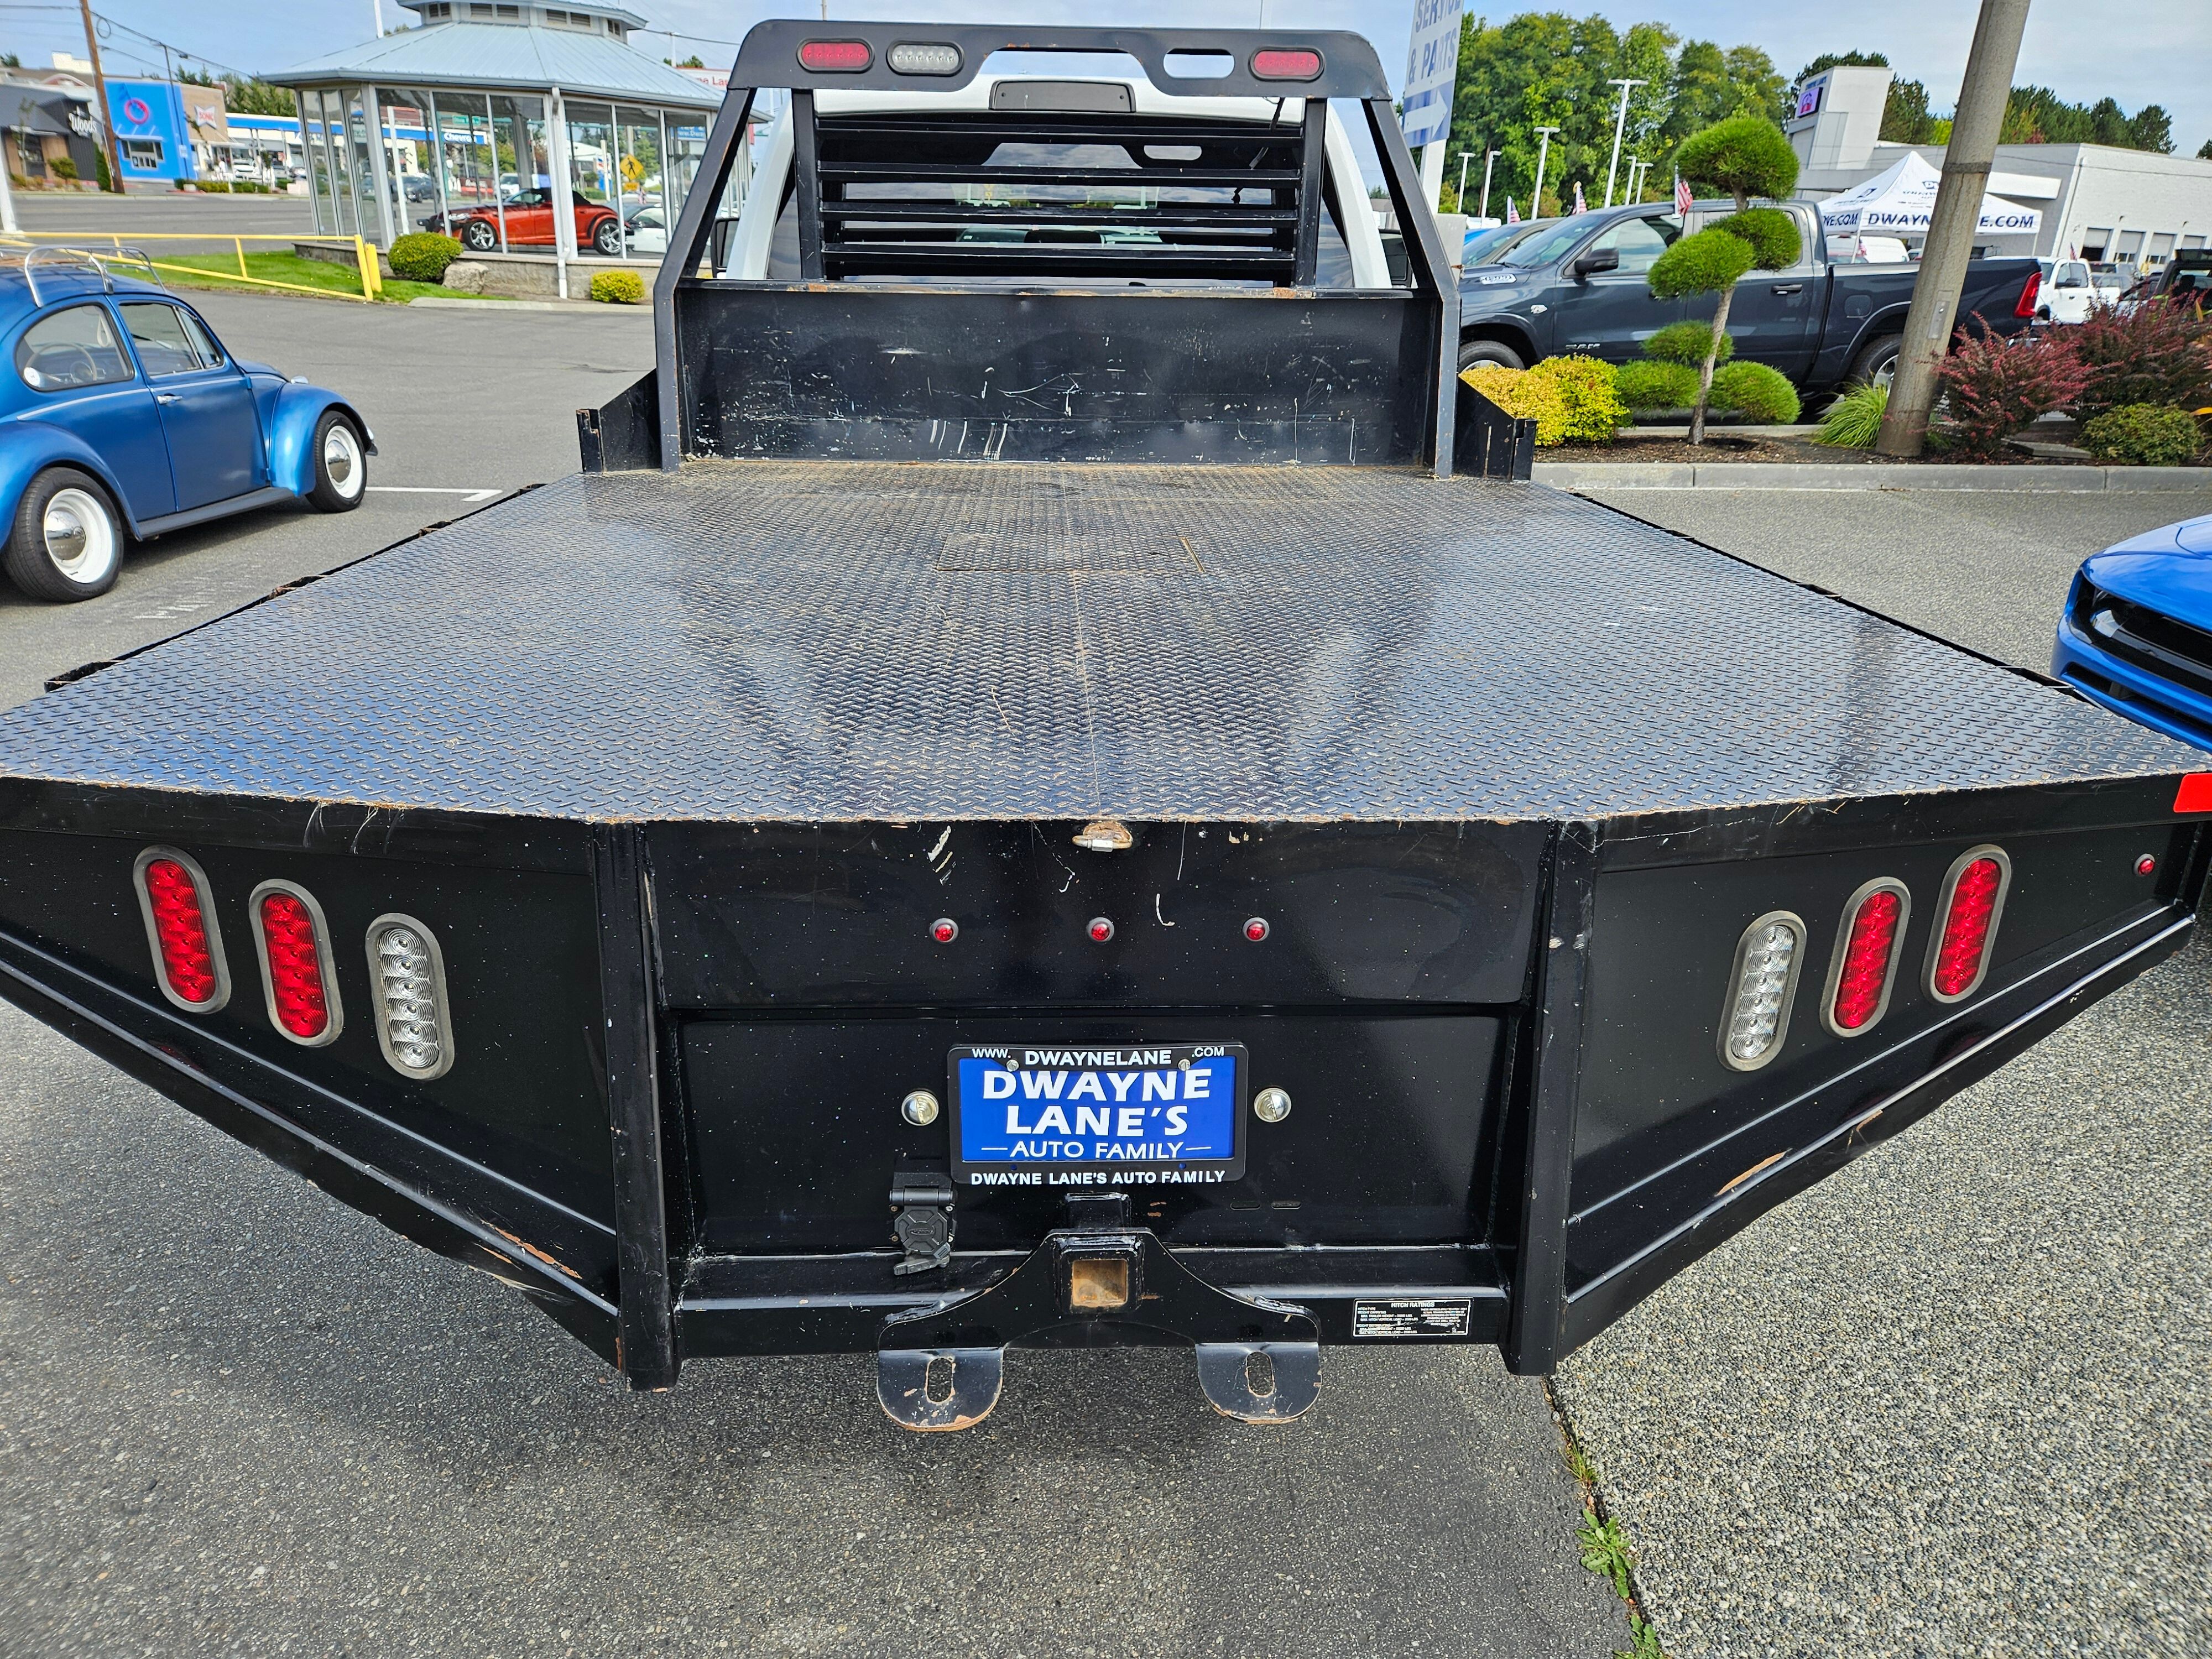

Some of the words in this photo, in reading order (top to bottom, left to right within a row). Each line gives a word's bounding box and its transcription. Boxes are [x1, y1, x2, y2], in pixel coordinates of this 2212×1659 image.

[1416, 0, 1460, 33] SERV
[1408, 48, 1416, 85] &
[1421, 27, 1457, 80] PARTS
[69, 112, 97, 133] Woods
[1025, 1050, 1172, 1066] DWAYNELANE
[1191, 1046, 1225, 1057] .COM
[983, 1068, 1212, 1102] DWAYNE
[1006, 1105, 1188, 1136] LANE'S
[1010, 1141, 1084, 1157] AUTO
[1095, 1141, 1184, 1159] FAMILY
[971, 1173, 1042, 1185] DWAYNE
[1049, 1172, 1107, 1185] LANE'S
[1112, 1171, 1156, 1184] AUTO
[1161, 1170, 1225, 1183] FAMILY
